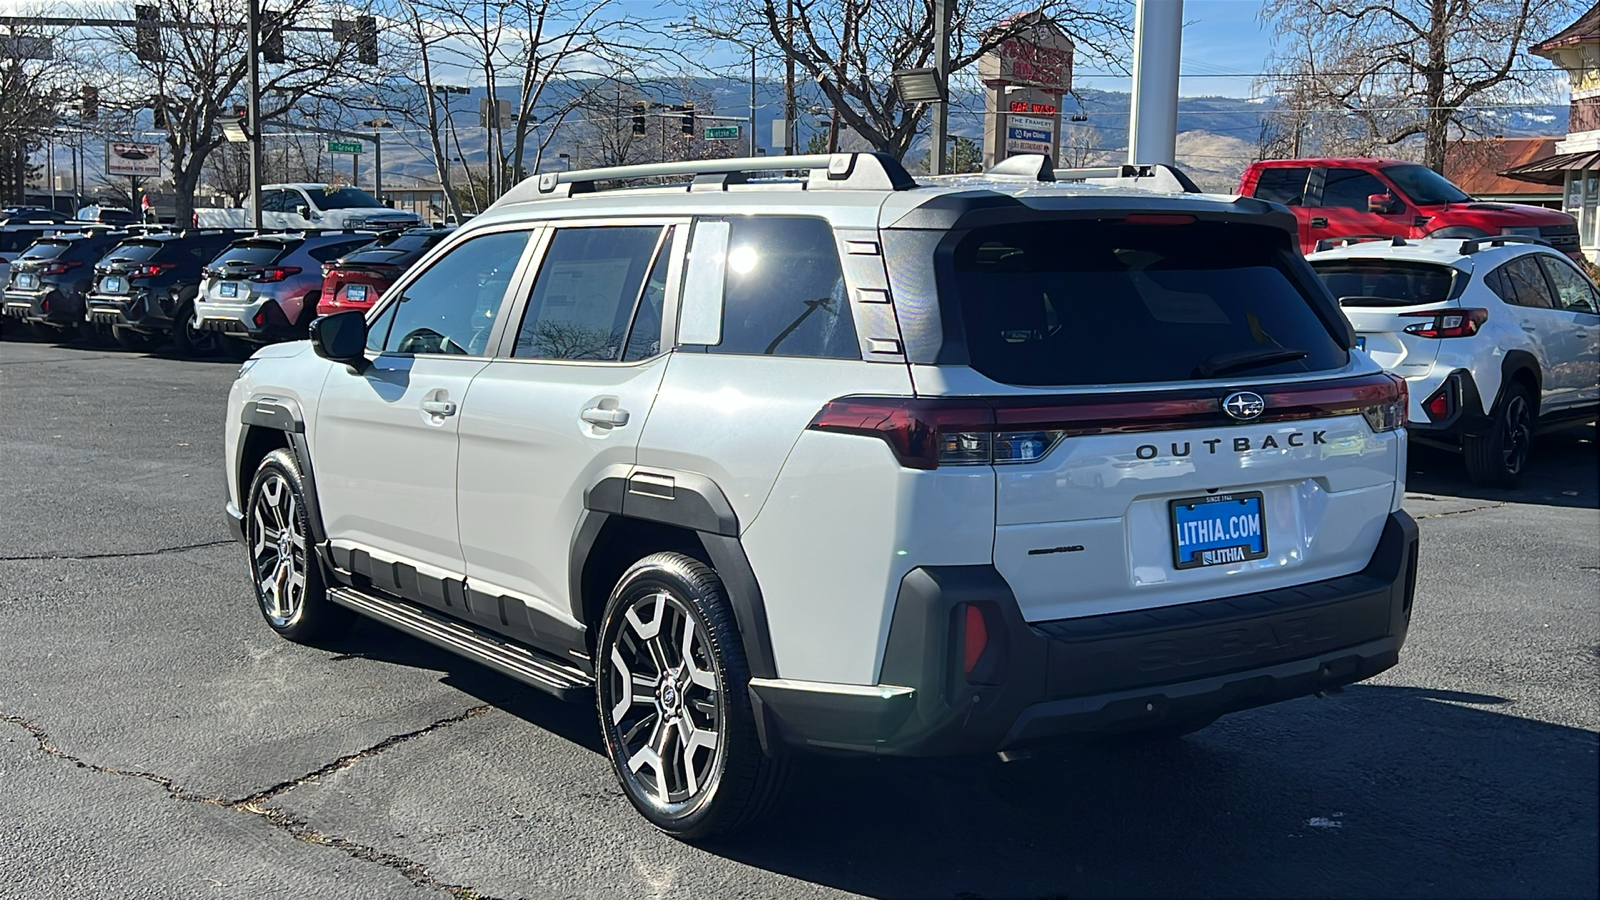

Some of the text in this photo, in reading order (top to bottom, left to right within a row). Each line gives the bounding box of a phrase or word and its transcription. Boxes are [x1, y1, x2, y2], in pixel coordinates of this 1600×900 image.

[1010, 101, 1056, 115] CAR WASH
[1023, 131, 1032, 139] Eye
[1136, 430, 1327, 460] OUTBACK
[1177, 513, 1260, 546] LITHIA.COM
[1212, 547, 1245, 563] LITHIA
